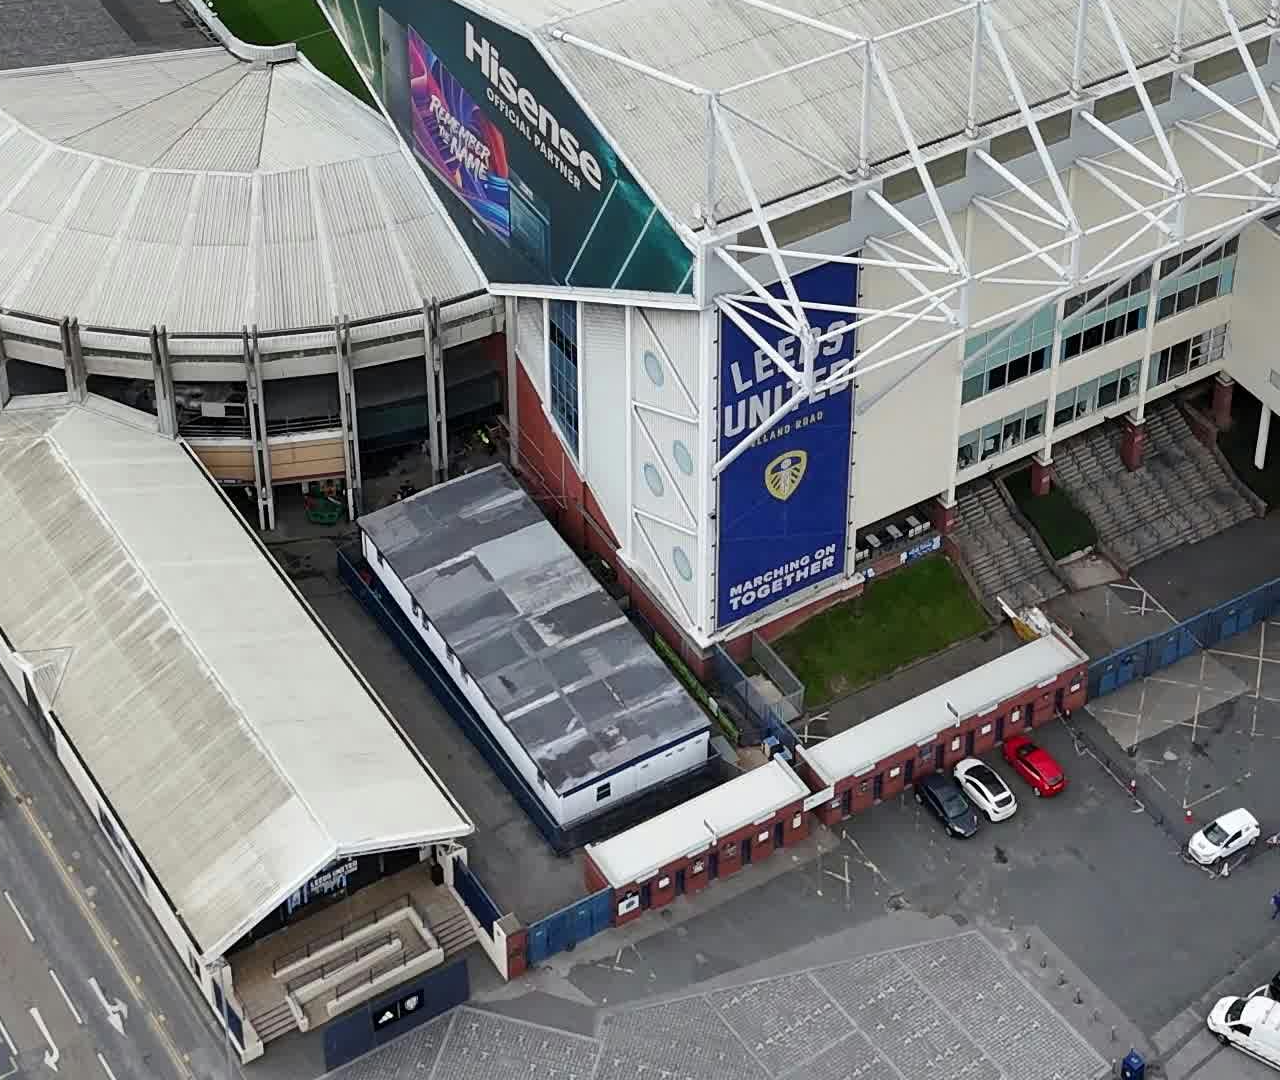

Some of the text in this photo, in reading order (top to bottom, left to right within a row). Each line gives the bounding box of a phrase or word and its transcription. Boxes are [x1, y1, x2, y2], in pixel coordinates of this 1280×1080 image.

[429, 94, 491, 167] REMEMBER
[465, 21, 603, 191] Hisense
[486, 87, 582, 191] OFFICIAL PARTNER
[450, 136, 490, 181] NAME
[730, 319, 848, 395] LEEDS
[724, 358, 851, 438] UNITED
[795, 411, 824, 430] ROAD
[729, 544, 836, 598] MARCHING ON
[729, 555, 835, 611] TOGETHER
